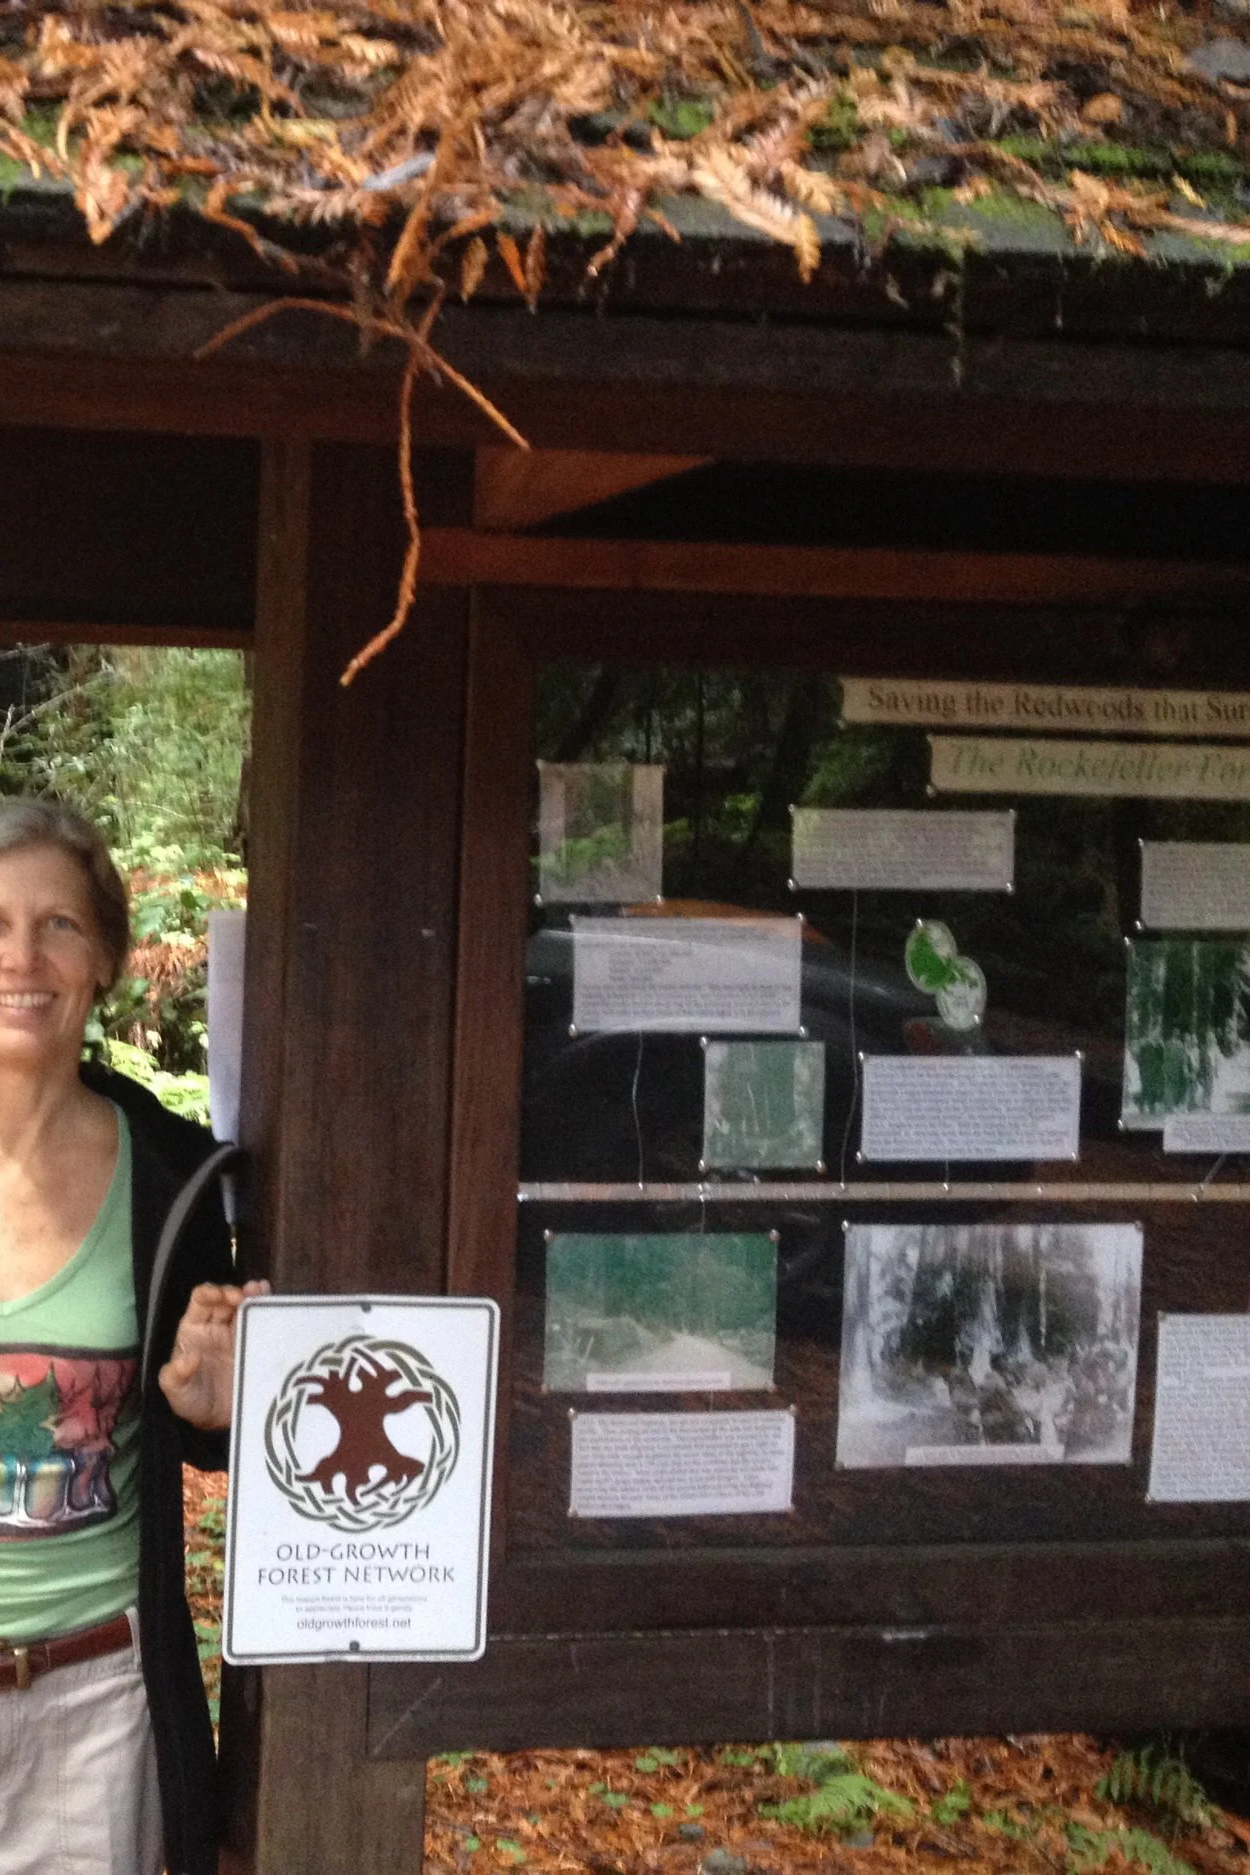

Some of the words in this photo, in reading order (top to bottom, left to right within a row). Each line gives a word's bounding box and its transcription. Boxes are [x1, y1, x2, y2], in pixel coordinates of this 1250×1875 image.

[868, 684, 956, 719] Saving
[966, 690, 1004, 713] the
[1014, 690, 1144, 721] Redwoods
[1154, 698, 1198, 722] that
[1016, 748, 1182, 784] Rockefeller
[276, 1543, 430, 1562] OLD-GROWTH
[258, 1567, 336, 1586] FOREST
[344, 1566, 455, 1584] NETWORK
